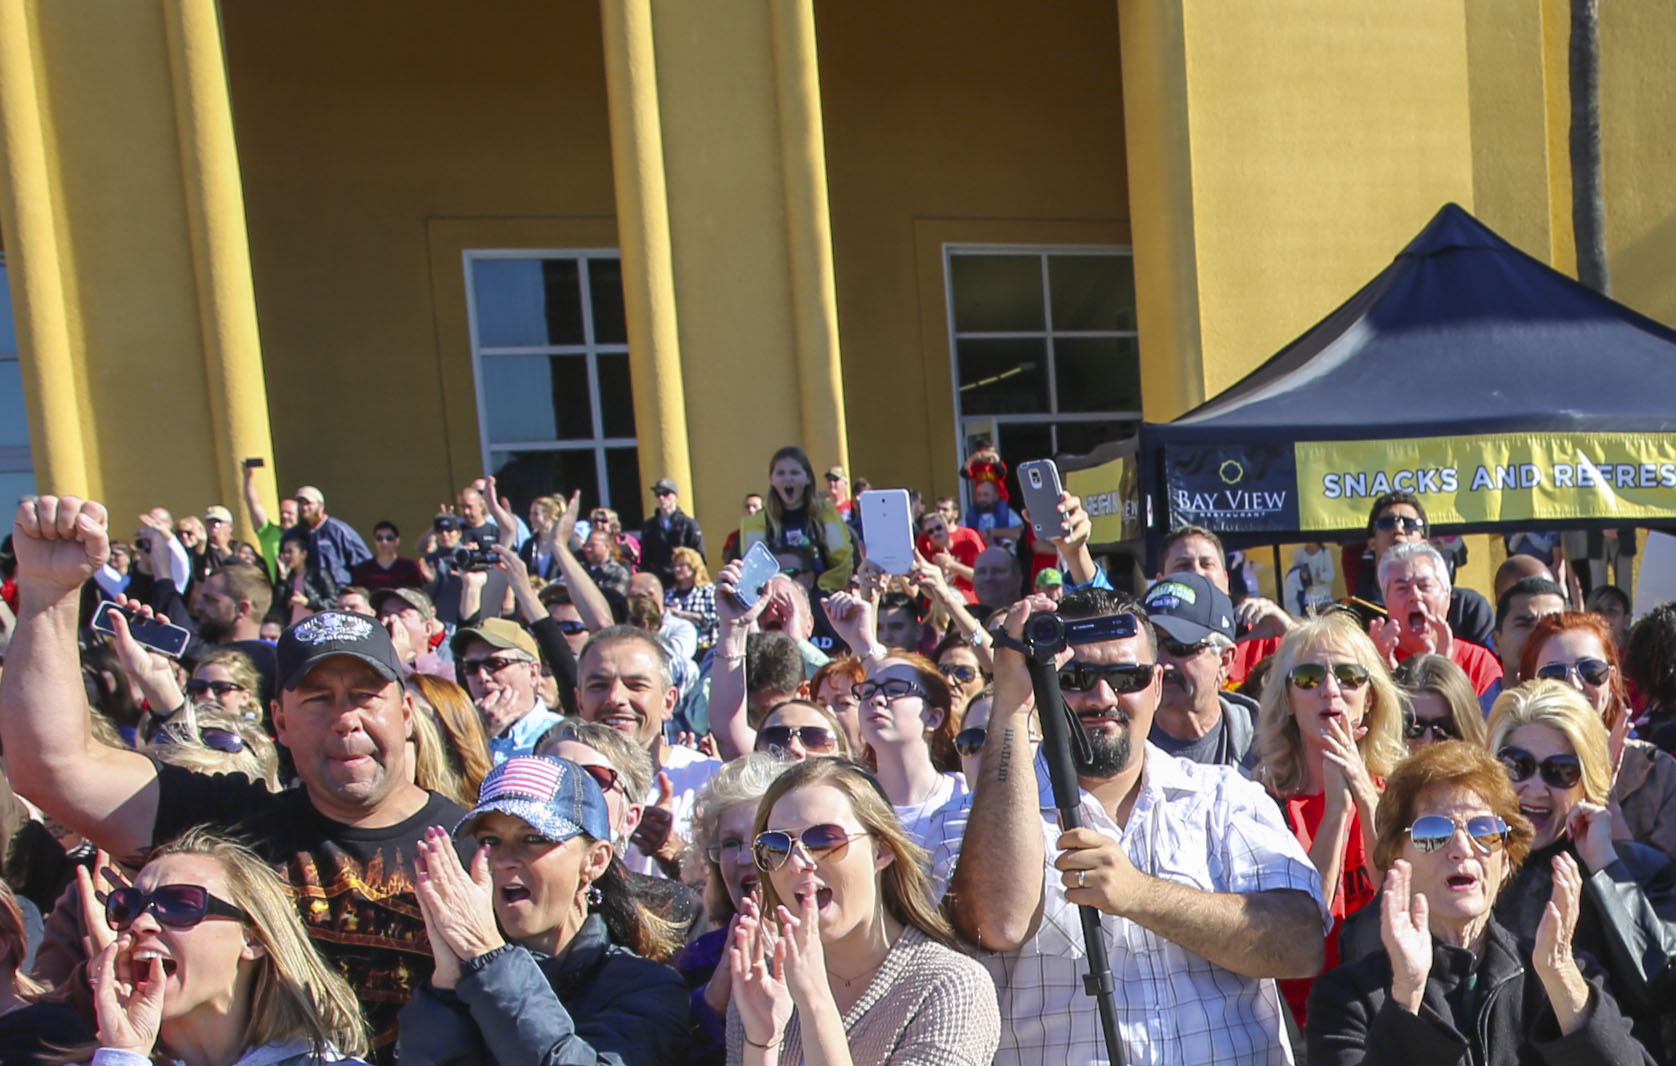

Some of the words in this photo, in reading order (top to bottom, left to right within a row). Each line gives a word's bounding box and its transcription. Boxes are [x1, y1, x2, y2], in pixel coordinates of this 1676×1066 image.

[1323, 466, 1459, 498] SNACKS
[1470, 464, 1542, 492] AND
[1178, 490, 1219, 510] BAY
[1225, 490, 1287, 509] VIEW
